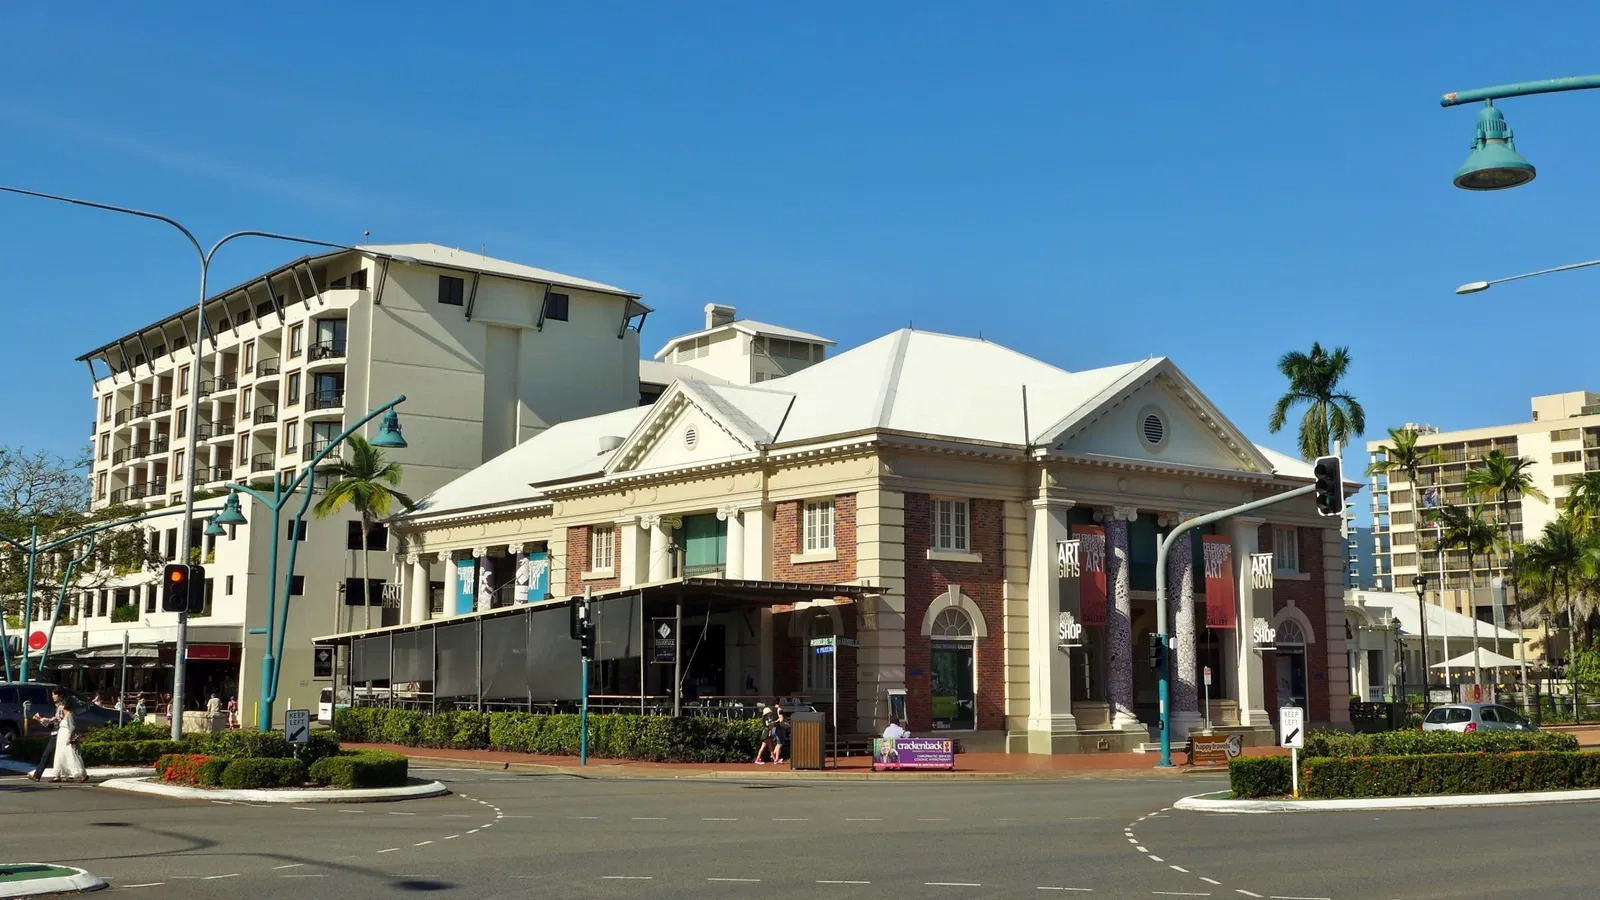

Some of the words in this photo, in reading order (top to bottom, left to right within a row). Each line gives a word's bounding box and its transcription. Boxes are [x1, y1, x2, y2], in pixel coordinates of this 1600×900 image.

[1058, 542, 1080, 564] ART
[1085, 551, 1106, 572] ART
[1205, 559, 1222, 578] ART
[1251, 556, 1273, 575] ART
[1058, 563, 1080, 578] GIFTS
[462, 578, 474, 595] ART
[1252, 573, 1274, 589] NOW
[382, 584, 401, 599] ART
[382, 598, 401, 608] GIFTS
[1060, 623, 1082, 639] SHOP
[1253, 628, 1276, 643] SHOP
[897, 741, 943, 750] crackenback
